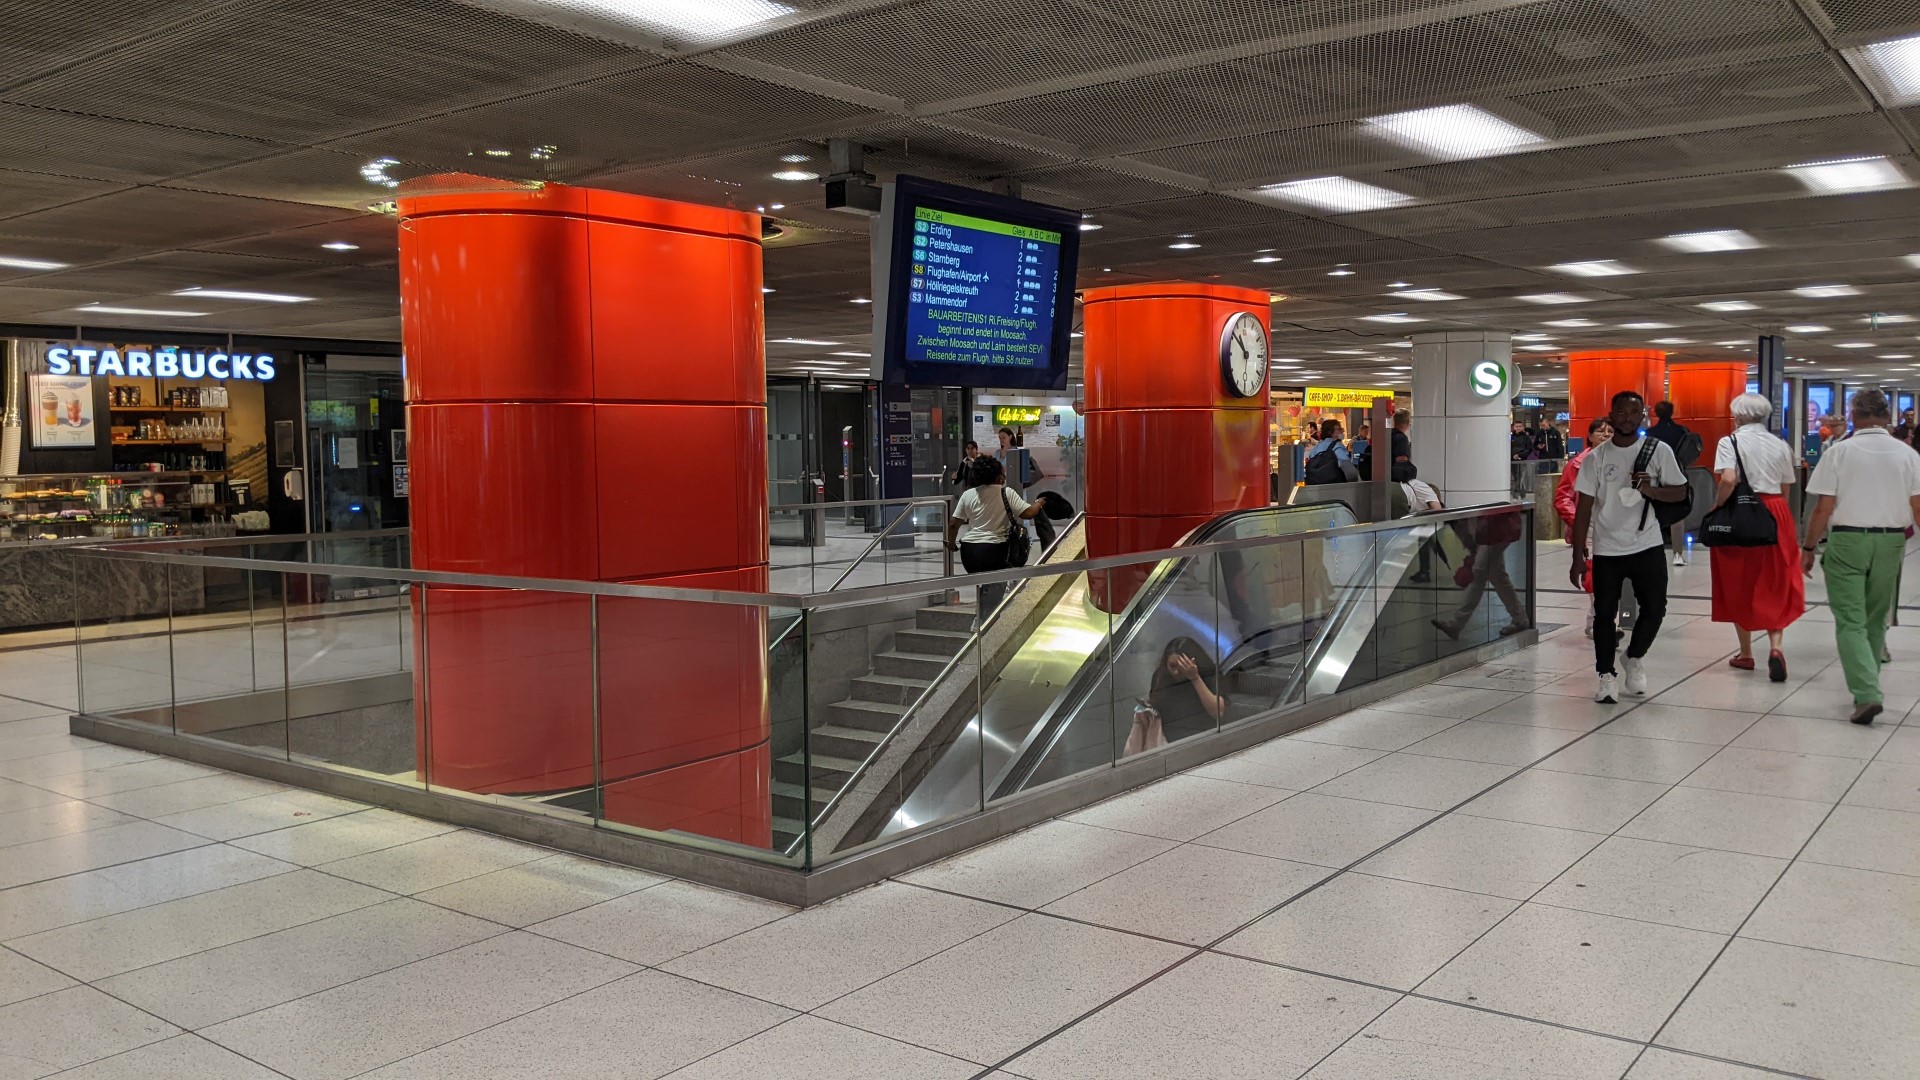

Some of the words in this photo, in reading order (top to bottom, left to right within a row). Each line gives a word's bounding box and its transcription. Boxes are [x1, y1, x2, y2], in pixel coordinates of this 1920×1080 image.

[916, 208, 930, 220] Linie
[931, 210, 942, 220] Ziel
[1013, 227, 1025, 236] Gleis
[930, 223, 951, 239] Erding
[1020, 240, 1024, 249] 1
[929, 238, 973, 254] Petershausen
[1018, 253, 1022, 262] 2
[914, 251, 925, 259] S6
[928, 253, 960, 267] Starnberg
[1017, 266, 1021, 276] 2
[1054, 271, 1058, 281] 2
[913, 279, 923, 287] S7
[926, 280, 978, 296] Höllriegelskreuth
[1015, 291, 1020, 301] 2
[914, 265, 924, 273] S8
[927, 266, 982, 283] Flughafen/Airport
[1052, 283, 1057, 293] 3
[912, 293, 922, 301] S3
[925, 294, 968, 308] Mammendorf
[1014, 304, 1018, 314] 2
[1050, 308, 1054, 317] 8
[918, 335, 948, 347] Zwischen
[950, 337, 978, 349] Moosach
[979, 340, 990, 350] und
[991, 341, 1005, 351] Laim
[1007, 342, 1027, 352] besteht
[938, 324, 961, 335] beginnt
[963, 326, 974, 336] und
[976, 327, 993, 337] endet
[994, 328, 999, 337] in
[1000, 329, 1028, 341] Moosach.
[48, 348, 275, 380] STARBUCKS
[926, 350, 956, 361] Reisende
[958, 353, 971, 361] zum
[972, 353, 990, 365] Flugh.
[992, 354, 1004, 363] bitte
[1006, 355, 1014, 363] S8
[1015, 356, 1033, 365] nutzen
[1475, 362, 1502, 397] S
